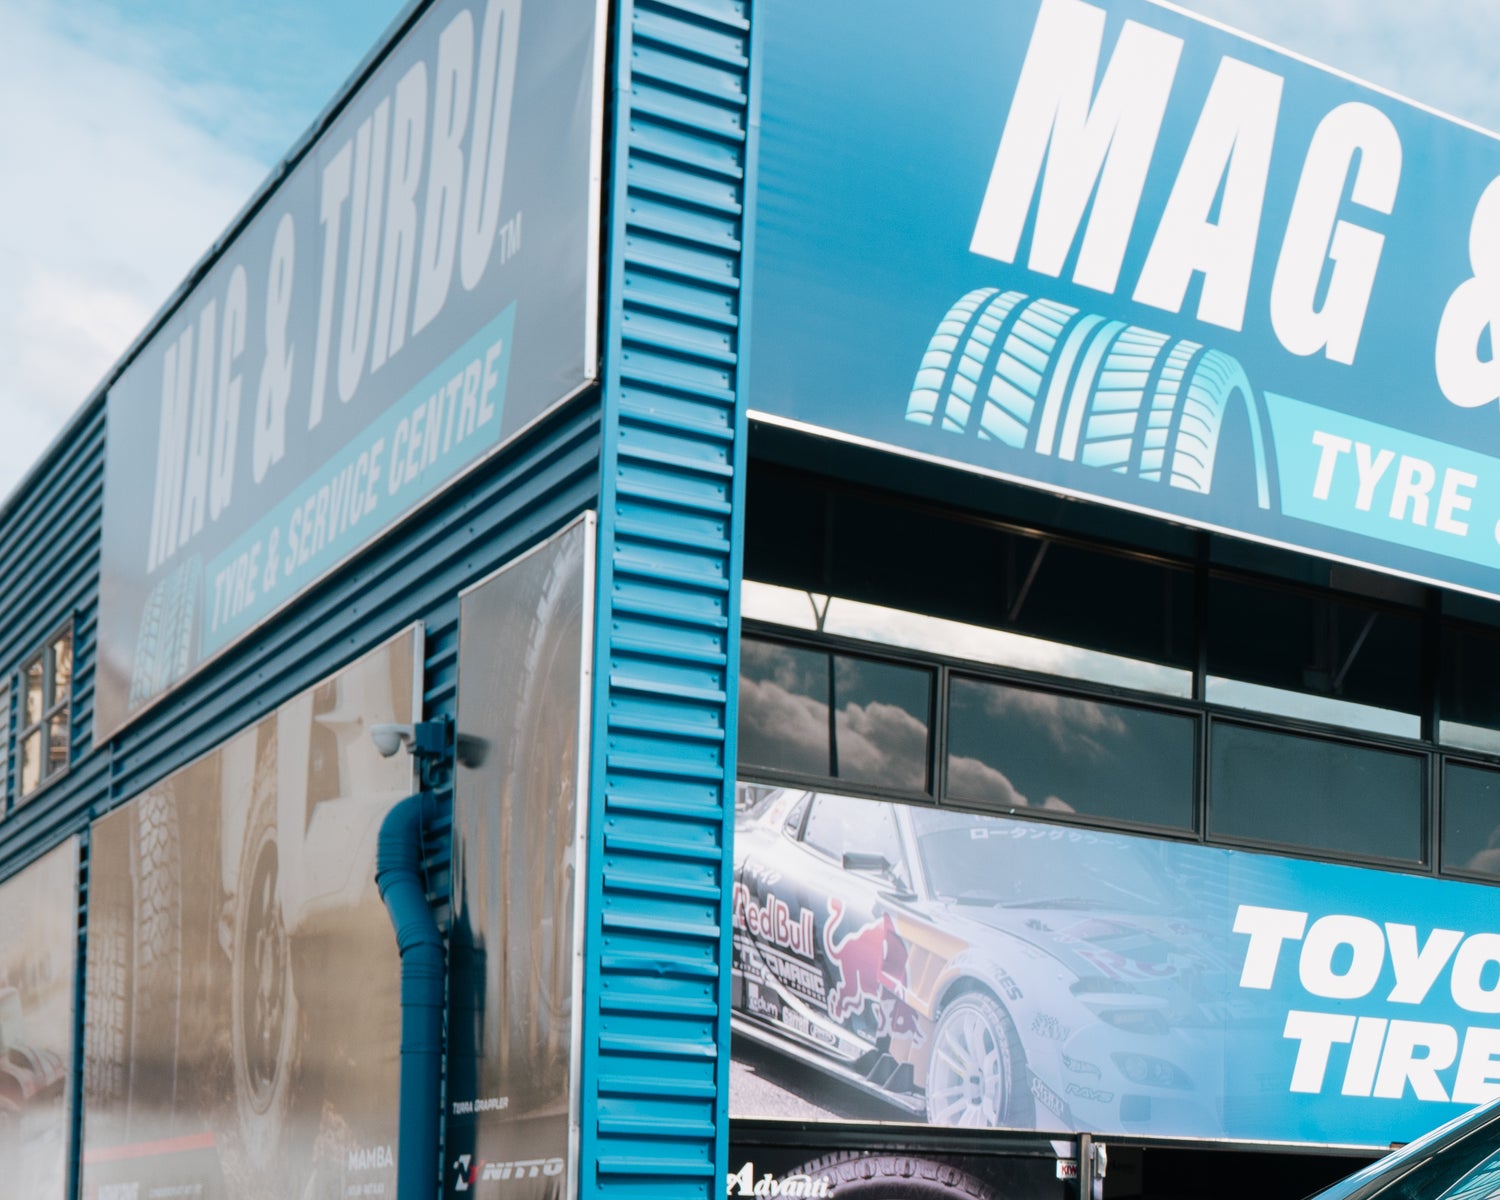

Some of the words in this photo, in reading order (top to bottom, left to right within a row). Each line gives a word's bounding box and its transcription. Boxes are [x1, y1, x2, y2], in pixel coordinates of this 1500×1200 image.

[969, 0, 1403, 366] MAG
[146, 264, 248, 574] MAG
[252, 212, 297, 485] &
[308, 0, 520, 431] TURBO
[209, 546, 258, 633] TYRE
[261, 536, 280, 596] &
[285, 459, 381, 577] SERVICE
[387, 338, 503, 497] CENTRE
[1309, 430, 1478, 536] TYRE
[349, 1145, 394, 1171] MAMBA
[481, 1157, 564, 1181] NITTO
